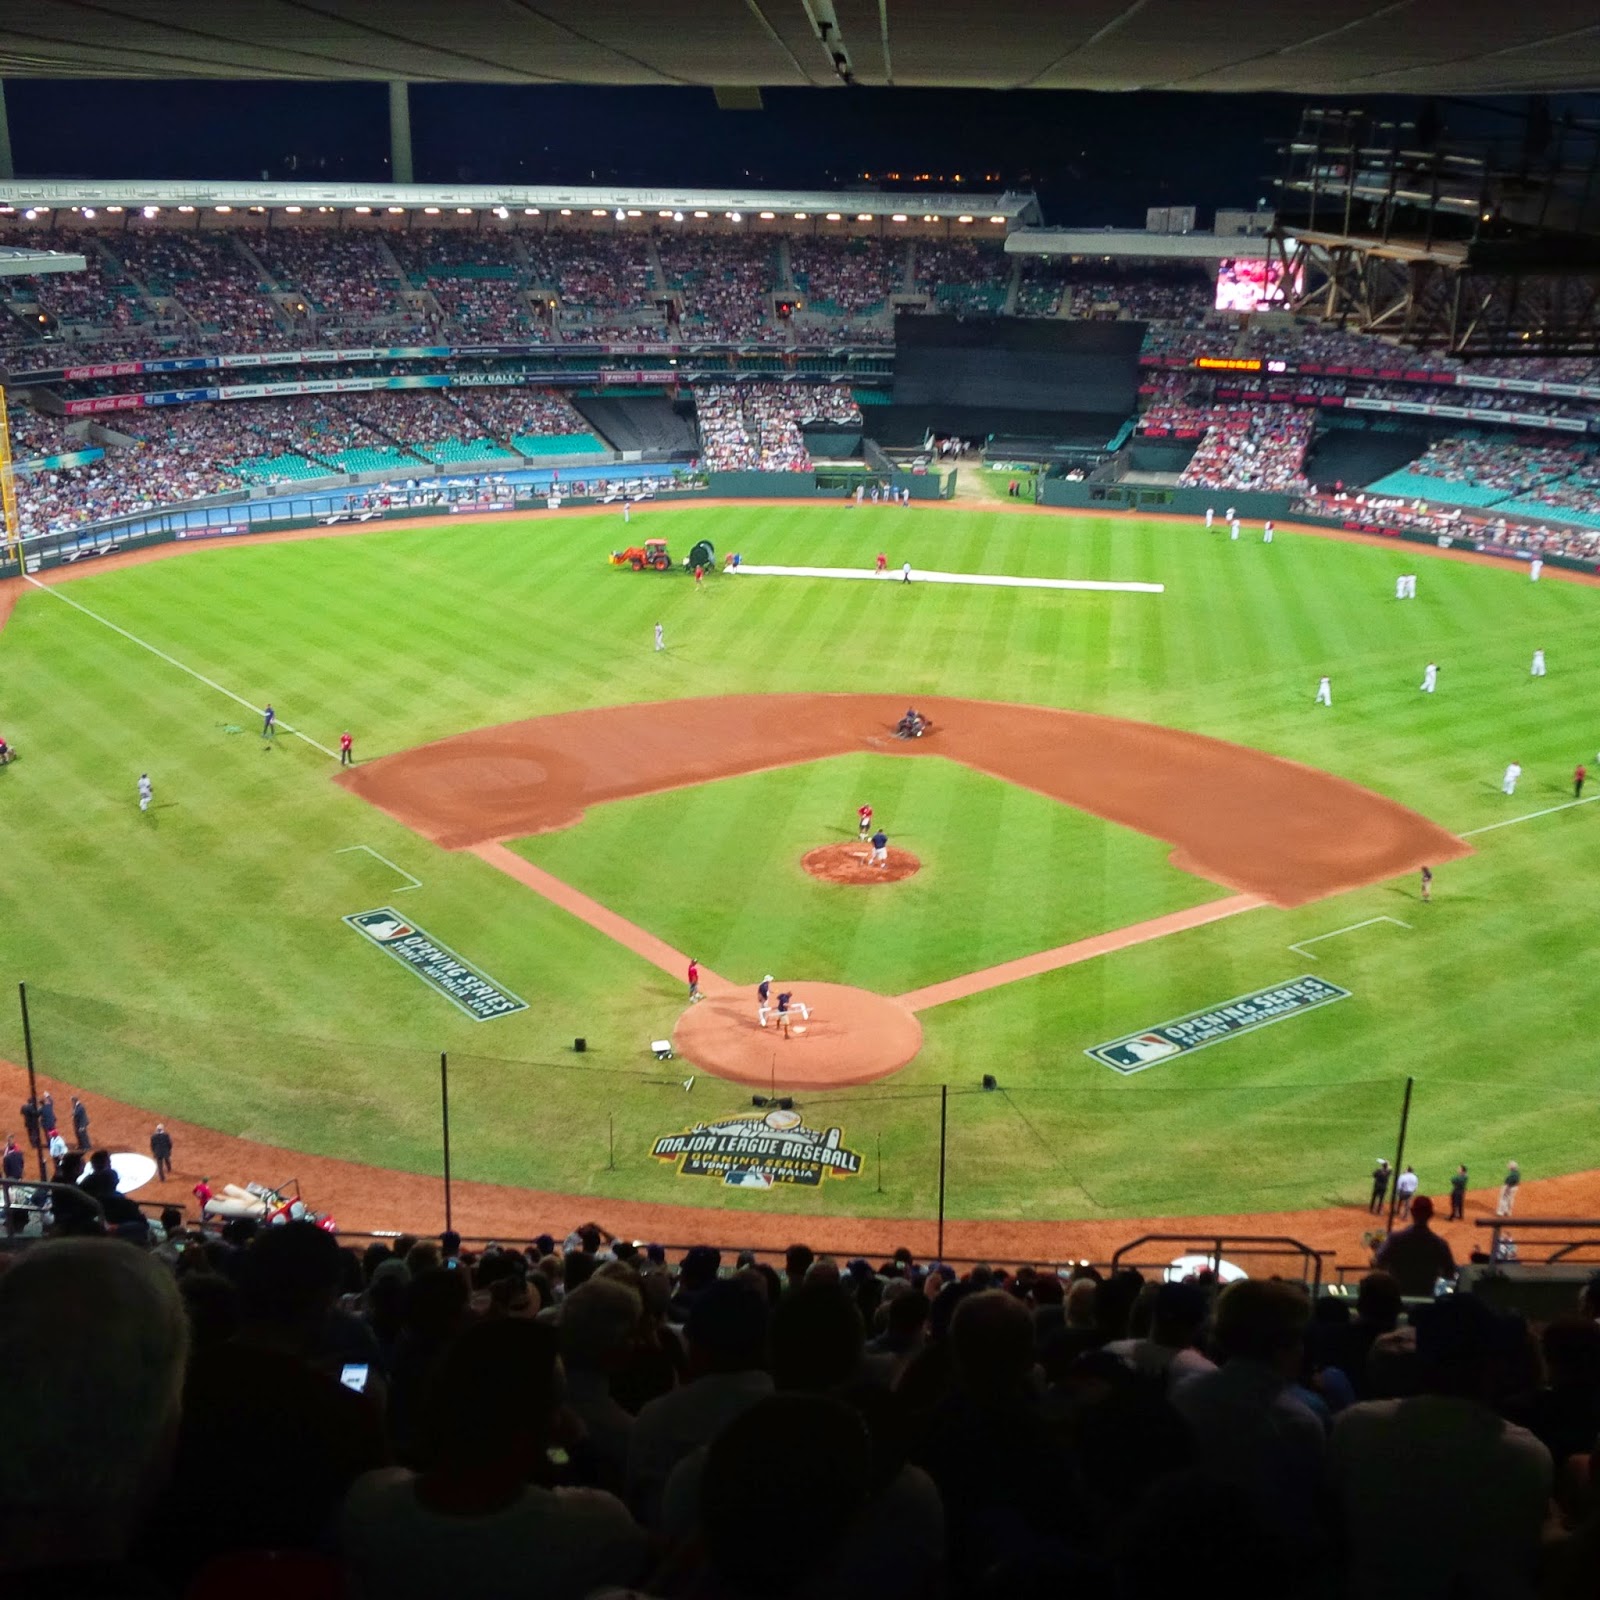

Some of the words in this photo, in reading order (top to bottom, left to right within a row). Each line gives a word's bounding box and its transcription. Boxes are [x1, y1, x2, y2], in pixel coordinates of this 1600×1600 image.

[460, 374, 486, 383] PLAY
[403, 936, 468, 978] OPENING
[457, 970, 515, 1012] SERIES
[1164, 1001, 1258, 1039] OPENING
[1255, 979, 1324, 1009] SERIES
[655, 1136, 717, 1154] MAJOR
[718, 1137, 780, 1155] LEAGUE
[781, 1141, 857, 1172] BASEBALL
[691, 1153, 760, 1165] OPENING
[763, 1158, 821, 1171] SERIES
[692, 1159, 739, 1171] SYDNEY
[748, 1165, 813, 1177] AUSTRALIA
